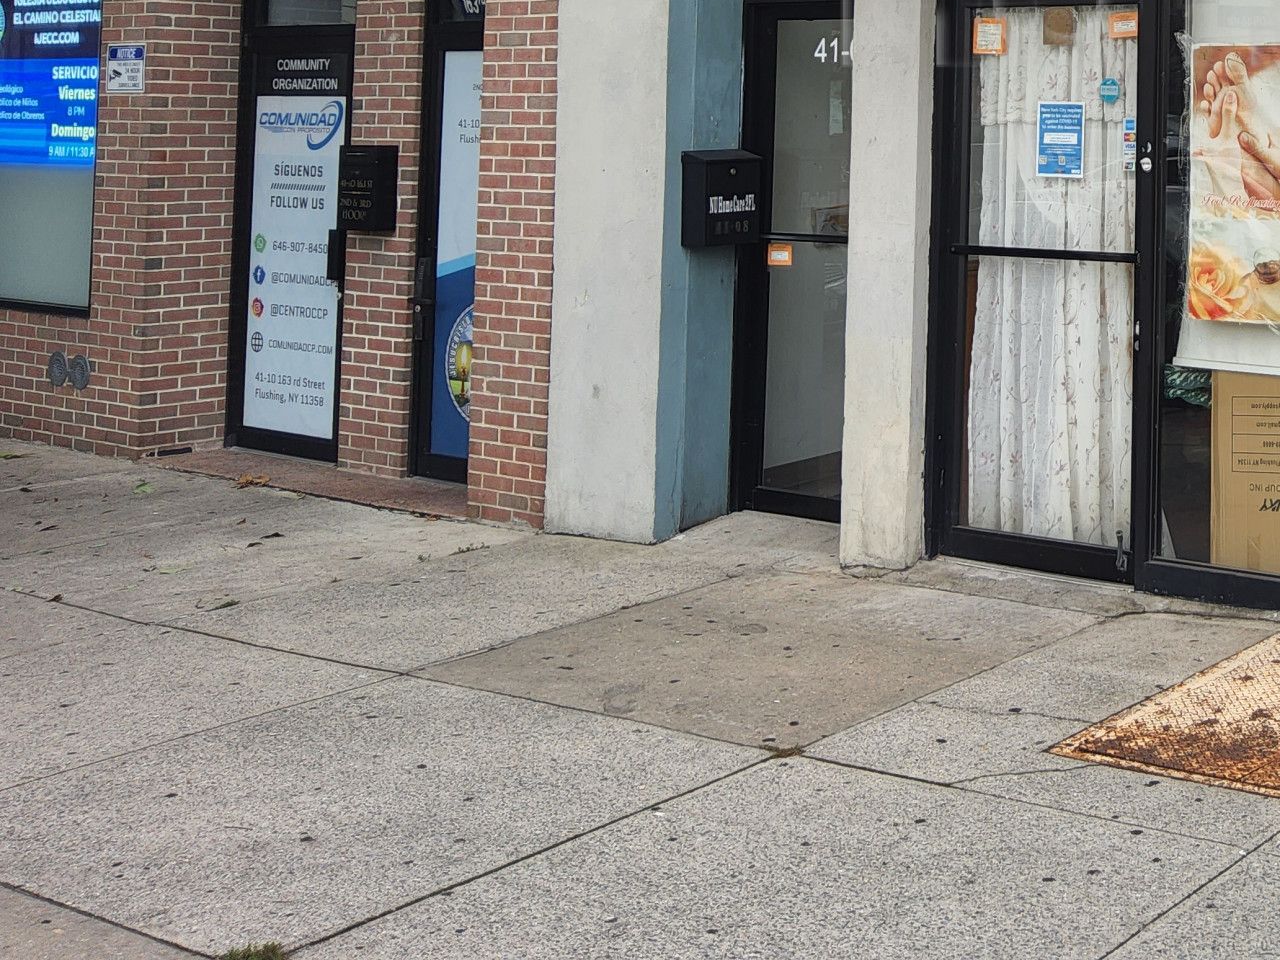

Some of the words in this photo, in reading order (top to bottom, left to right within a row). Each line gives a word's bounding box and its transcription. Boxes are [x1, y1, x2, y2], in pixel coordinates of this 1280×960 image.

[13, 13, 23, 25] EL
[24, 10, 59, 24] CAMINO
[116, 48, 136, 59] NOTICE
[813, 37, 854, 64] 41-
[277, 58, 331, 71] COMMUNITY
[272, 78, 338, 90] ORGANIZATION
[58, 86, 96, 100] Viernes
[73, 107, 85, 116] PM
[259, 112, 337, 126] COMUNIDAD
[458, 119, 480, 129] 41-10
[51, 124, 95, 140] Domingo
[48, 145, 53, 156] 9
[53, 146, 65, 156] AM
[71, 146, 89, 158] 11:30
[274, 161, 323, 178] SÍGUENOS
[270, 196, 309, 209] FOLLOW
[311, 197, 325, 210] US
[709, 196, 718, 214] NU
[718, 196, 733, 213] Home
[733, 195, 745, 212] Care
[745, 194, 756, 212] 2FL
[1201, 193, 1225, 208] Foot
[270, 304, 328, 320] @CENTROCCP
[268, 339, 333, 355] COMUNIDADCP.COM
[255, 372, 276, 384] 41-10
[277, 374, 292, 386] 163
[293, 376, 301, 387] rd
[303, 376, 325, 390] Street
[255, 388, 287, 404] Flushing,
[288, 392, 299, 404] NY
[301, 394, 324, 407] 11358
[1249, 483, 1263, 493] INC
